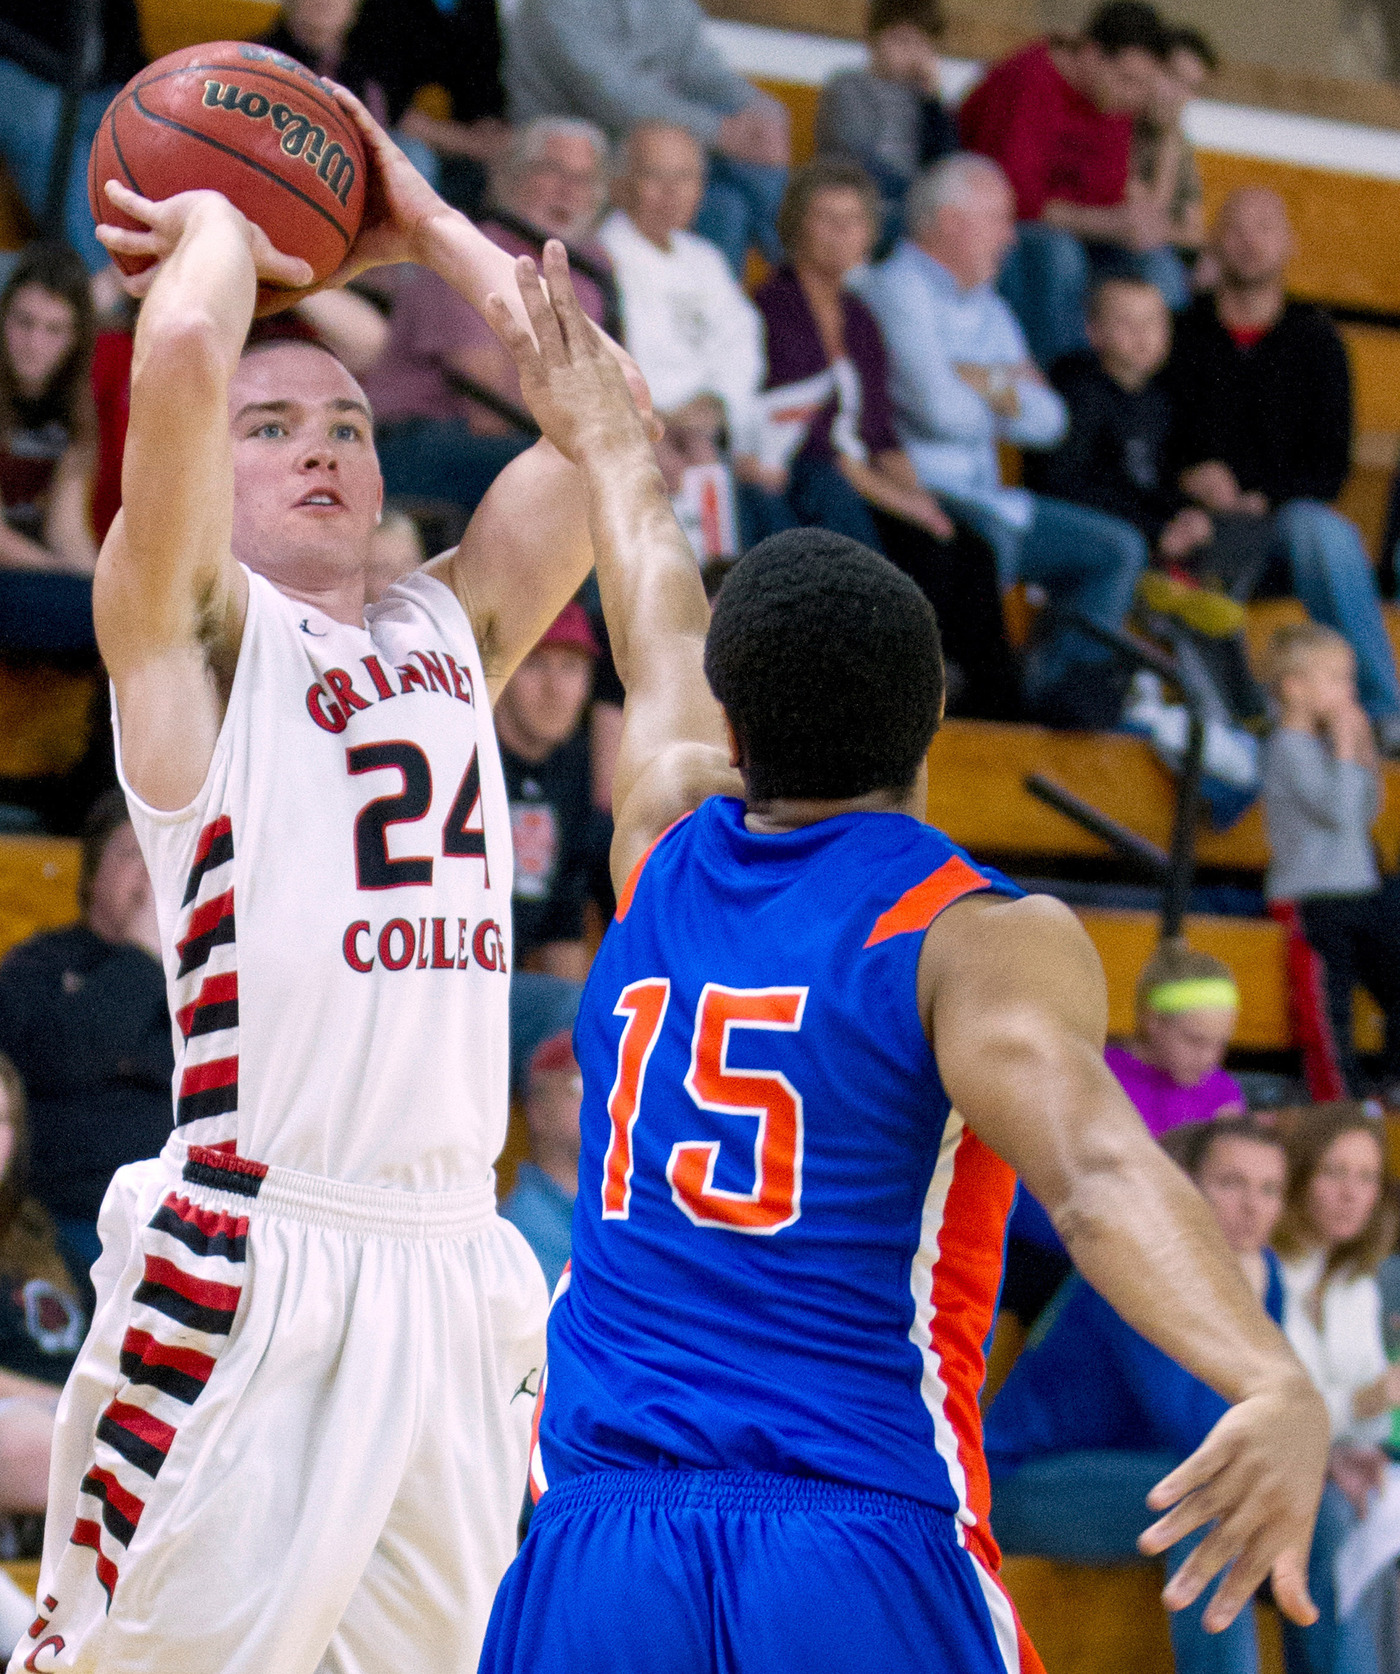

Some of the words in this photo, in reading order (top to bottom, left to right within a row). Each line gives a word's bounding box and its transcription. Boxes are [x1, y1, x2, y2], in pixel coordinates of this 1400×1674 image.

[203, 79, 355, 208] Wilson
[345, 739, 491, 890] 24
[602, 977, 810, 1236] 15
